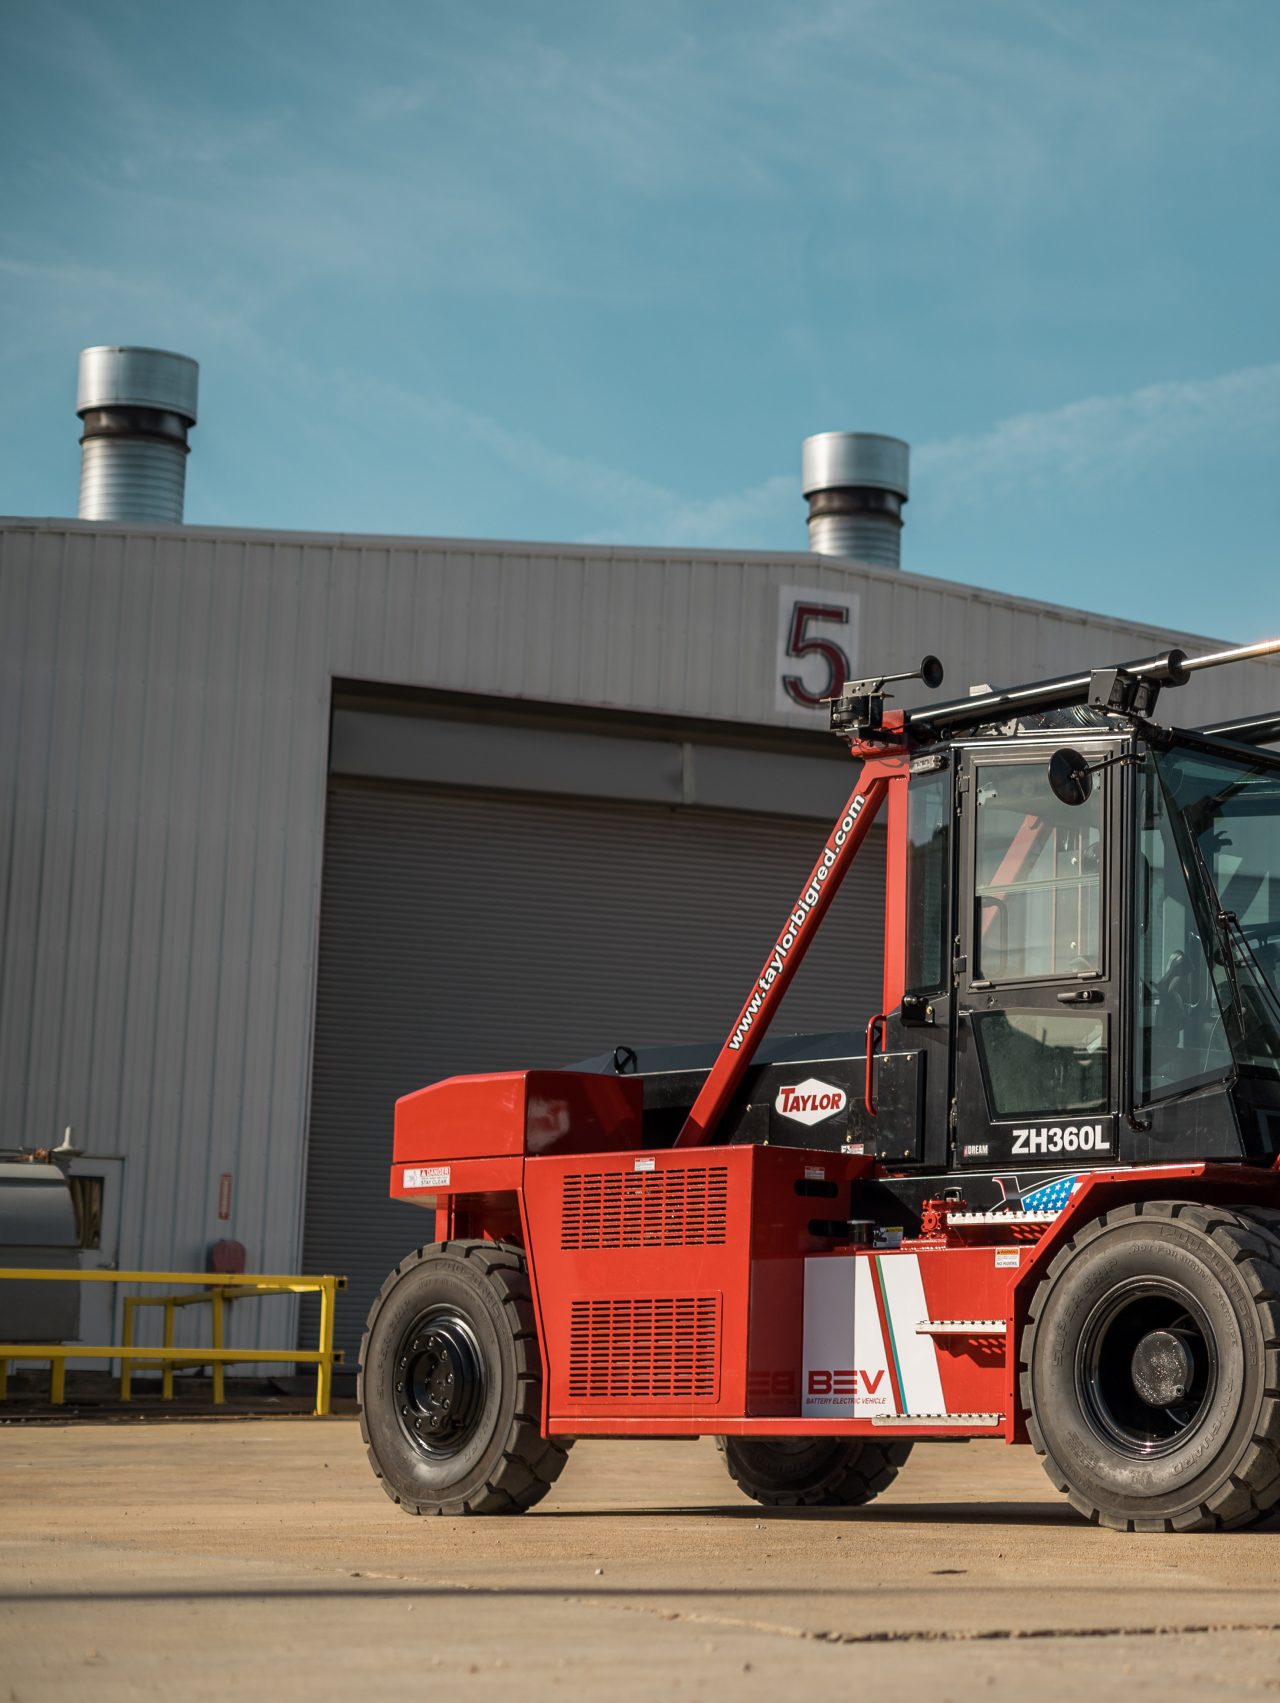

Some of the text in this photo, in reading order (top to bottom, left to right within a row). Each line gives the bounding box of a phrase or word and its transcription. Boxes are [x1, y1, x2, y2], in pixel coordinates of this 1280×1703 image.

[782, 600, 851, 709] 5
[729, 794, 865, 1051] www.taylorbigred.com
[780, 1087, 842, 1112] TAYLOR
[1011, 1124, 1111, 1154] ZH360L
[808, 1370, 885, 1394] BEV
[806, 1397, 887, 1405] BATTERY ELECTRIC VEHICLE
